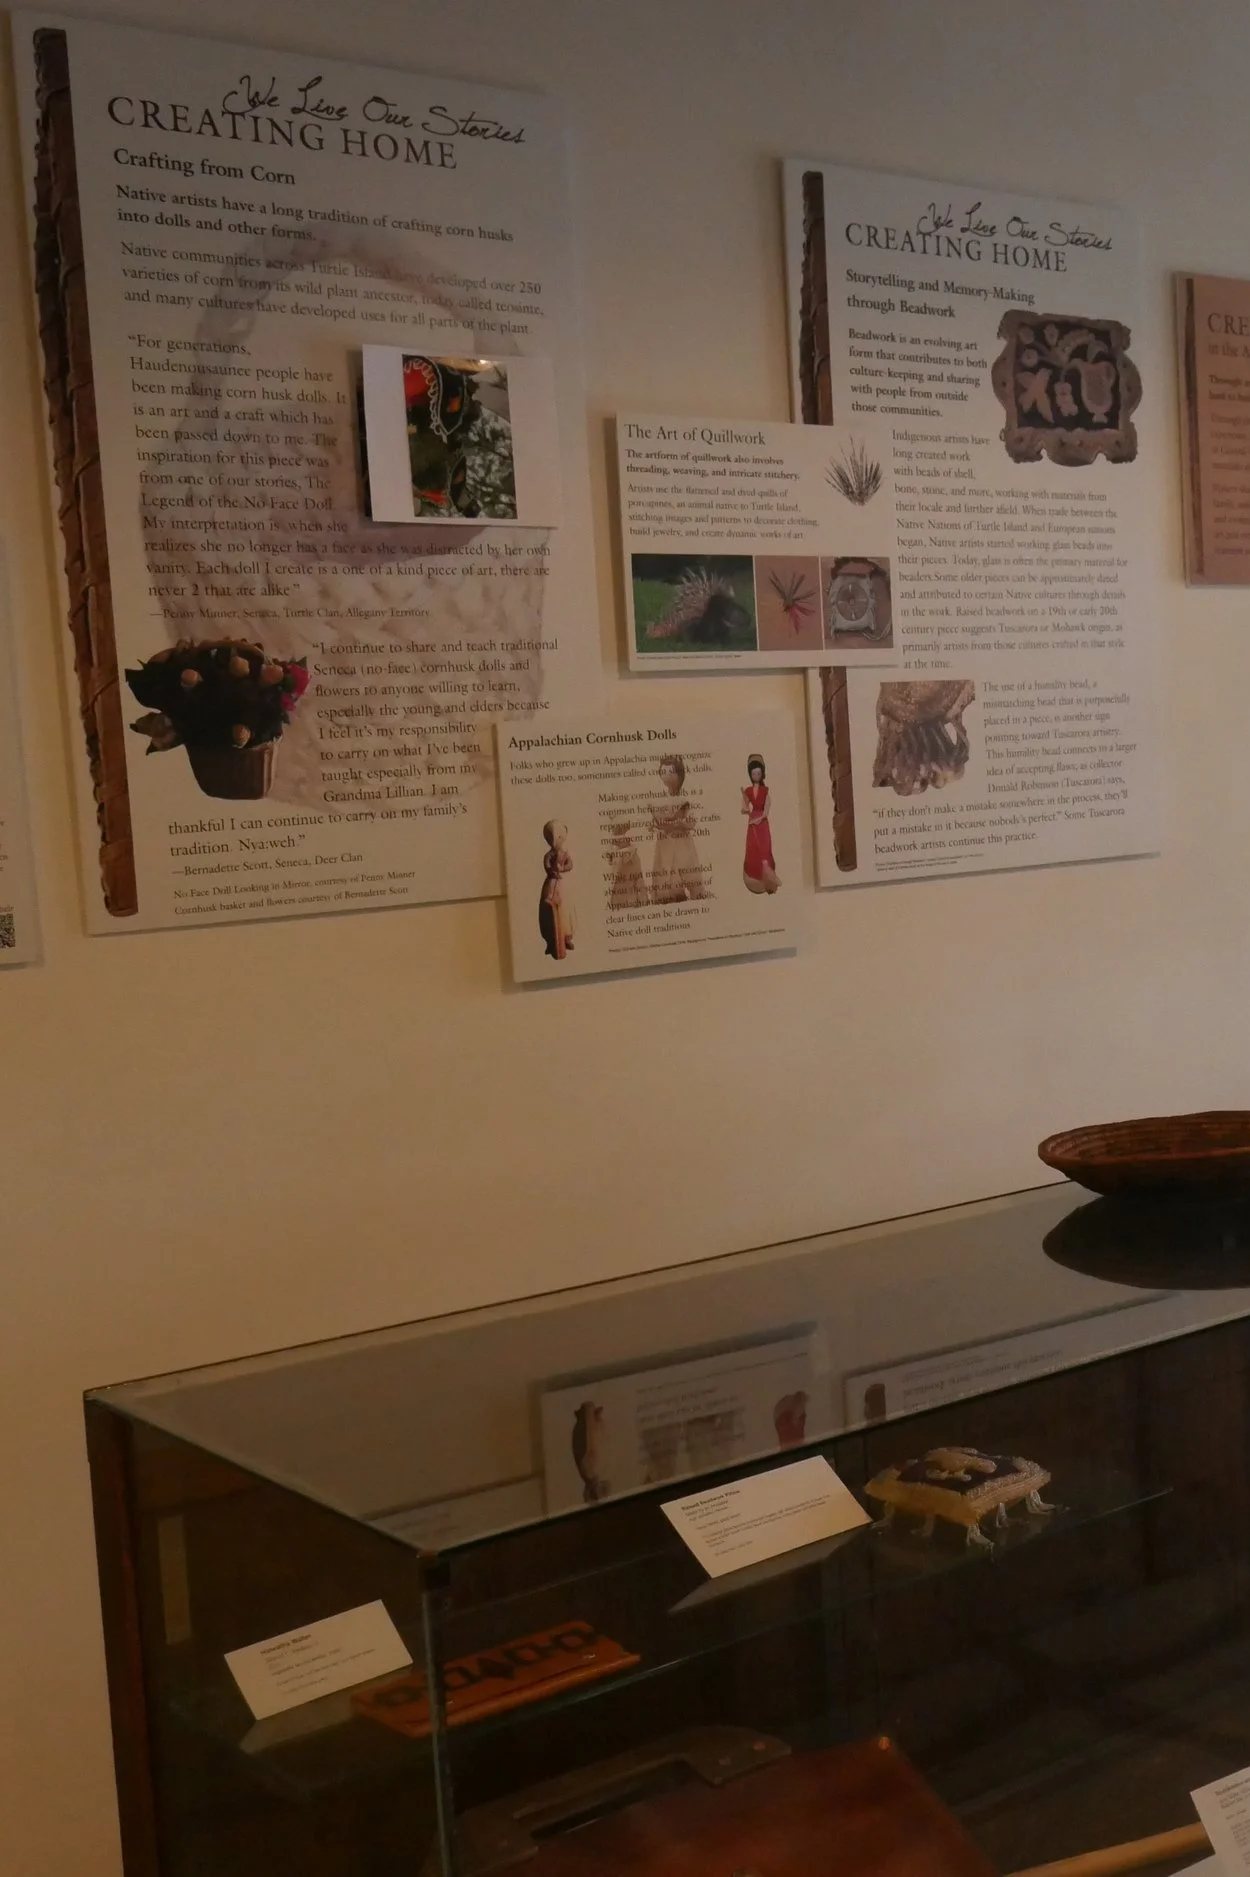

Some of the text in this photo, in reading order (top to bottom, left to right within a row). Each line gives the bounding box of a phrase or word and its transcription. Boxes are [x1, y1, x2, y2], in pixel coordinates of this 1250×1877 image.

[222, 72, 525, 143] We Live Our Stories
[108, 96, 457, 169] CREATING HOME
[113, 148, 295, 186] Crafting from Corn
[116, 184, 514, 242] Native artists have a long tradition of crafting corn husks
[118, 208, 316, 241] into dolls and other forms.
[917, 201, 1112, 250] We Live Our Stories
[845, 222, 1067, 272] CREATING HOME
[120, 241, 167, 259] Native
[172, 250, 261, 268] communities
[312, 261, 349, 276] Turtle
[354, 264, 392, 279] Island
[395, 270, 422, 283] have
[427, 273, 487, 292] developed
[491, 282, 514, 293] over
[520, 281, 542, 294] 250
[122, 266, 180, 282] varieties
[185, 271, 200, 283] of
[203, 275, 234, 287] corn
[239, 275, 271, 290] from
[276, 279, 290, 292] its
[295, 281, 322, 295] wild
[327, 284, 358, 299] plant
[459, 298, 492, 312] called
[845, 269, 1035, 306] Storytelling and Memory-Making
[124, 289, 150, 303] and
[156, 294, 193, 309] many
[198, 296, 252, 312] cultures
[256, 299, 286, 313] have
[290, 302, 355, 320] developed
[361, 310, 385, 322] uses
[390, 312, 408, 324] for
[412, 313, 425, 325] all
[430, 316, 458, 329] parts
[462, 318, 476, 330] of
[478, 319, 497, 331] the
[847, 295, 956, 318] through Beadwork
[849, 328, 978, 352] Beadwork is an evolving art
[849, 346, 987, 369] form that contributes to both
[256, 367, 299, 382] people
[304, 368, 333, 382] have
[927, 370, 943, 383] and
[946, 373, 980, 388] sharing
[132, 378, 166, 394] been
[171, 381, 222, 397] making
[226, 388, 256, 399] corn
[262, 386, 292, 401] husk
[337, 392, 347, 405] It
[851, 383, 969, 401] with people from outside
[133, 403, 334, 425] is an art and a craft which has
[852, 402, 943, 417] those communities.
[624, 424, 765, 446] The Art of Quillwork
[625, 449, 784, 465] The artform of quillwork also involves
[627, 465, 800, 481] threading, weaving, and intricate stitchery.
[508, 729, 677, 751] Appalachian Cornhusk Dolls
[169, 813, 224, 835] thankful
[230, 817, 236, 830] I
[240, 818, 263, 830] can
[267, 813, 324, 829] continue
[328, 813, 342, 824] to
[346, 810, 376, 823] carry
[381, 809, 398, 820] on
[401, 808, 420, 820] my
[242, 859, 274, 873] Scott,
[275, 856, 311, 870] Seneca,
[315, 854, 339, 865] Deer
[341, 853, 363, 863] Clan
